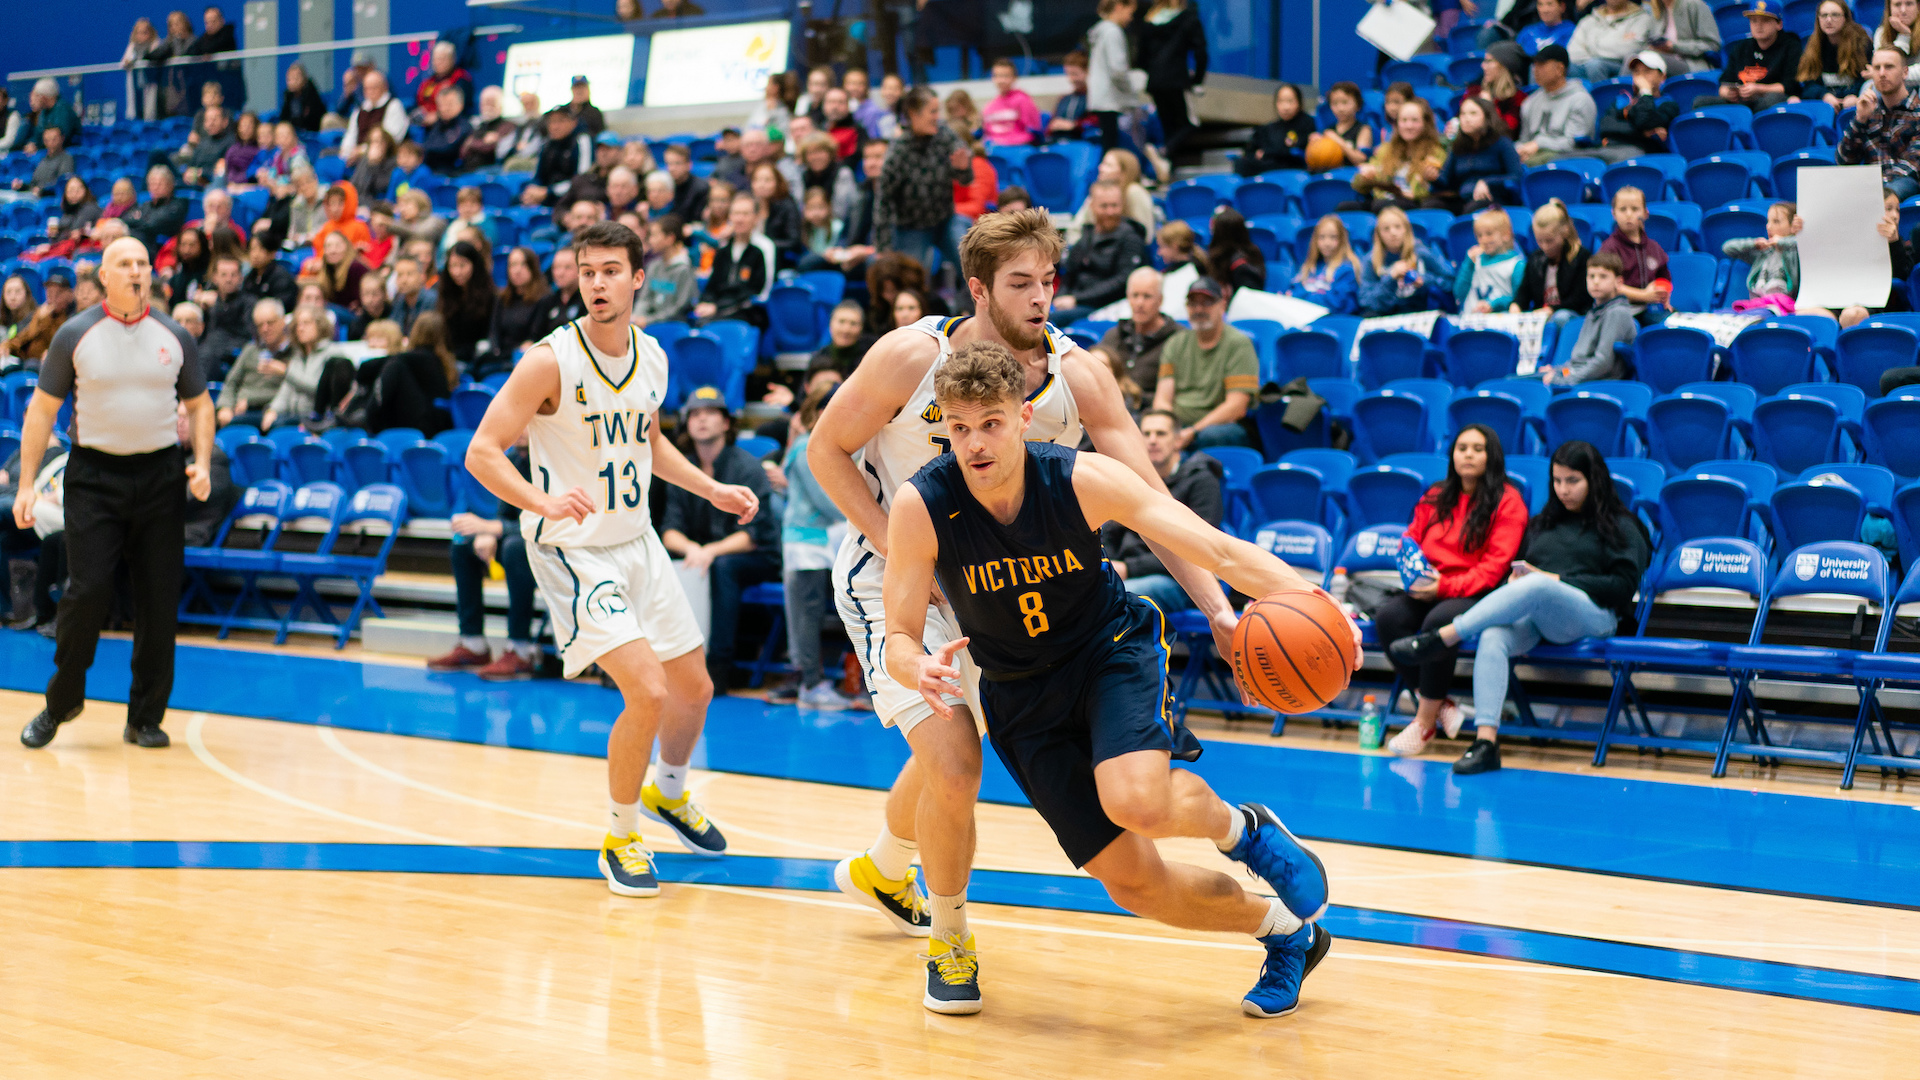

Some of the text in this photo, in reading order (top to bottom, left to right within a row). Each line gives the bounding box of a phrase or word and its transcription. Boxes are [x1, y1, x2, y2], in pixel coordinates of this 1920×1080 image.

[582, 409, 652, 450] TWU
[598, 457, 643, 513] 13
[962, 548, 1084, 594] VICTORIA
[1703, 562, 1749, 573] of Victoria
[1705, 551, 1752, 565] University
[1820, 567, 1868, 579] of Victoria
[1822, 557, 1871, 571] University
[1018, 591, 1050, 638] 8
[1254, 647, 1304, 708] EVOLUTION
